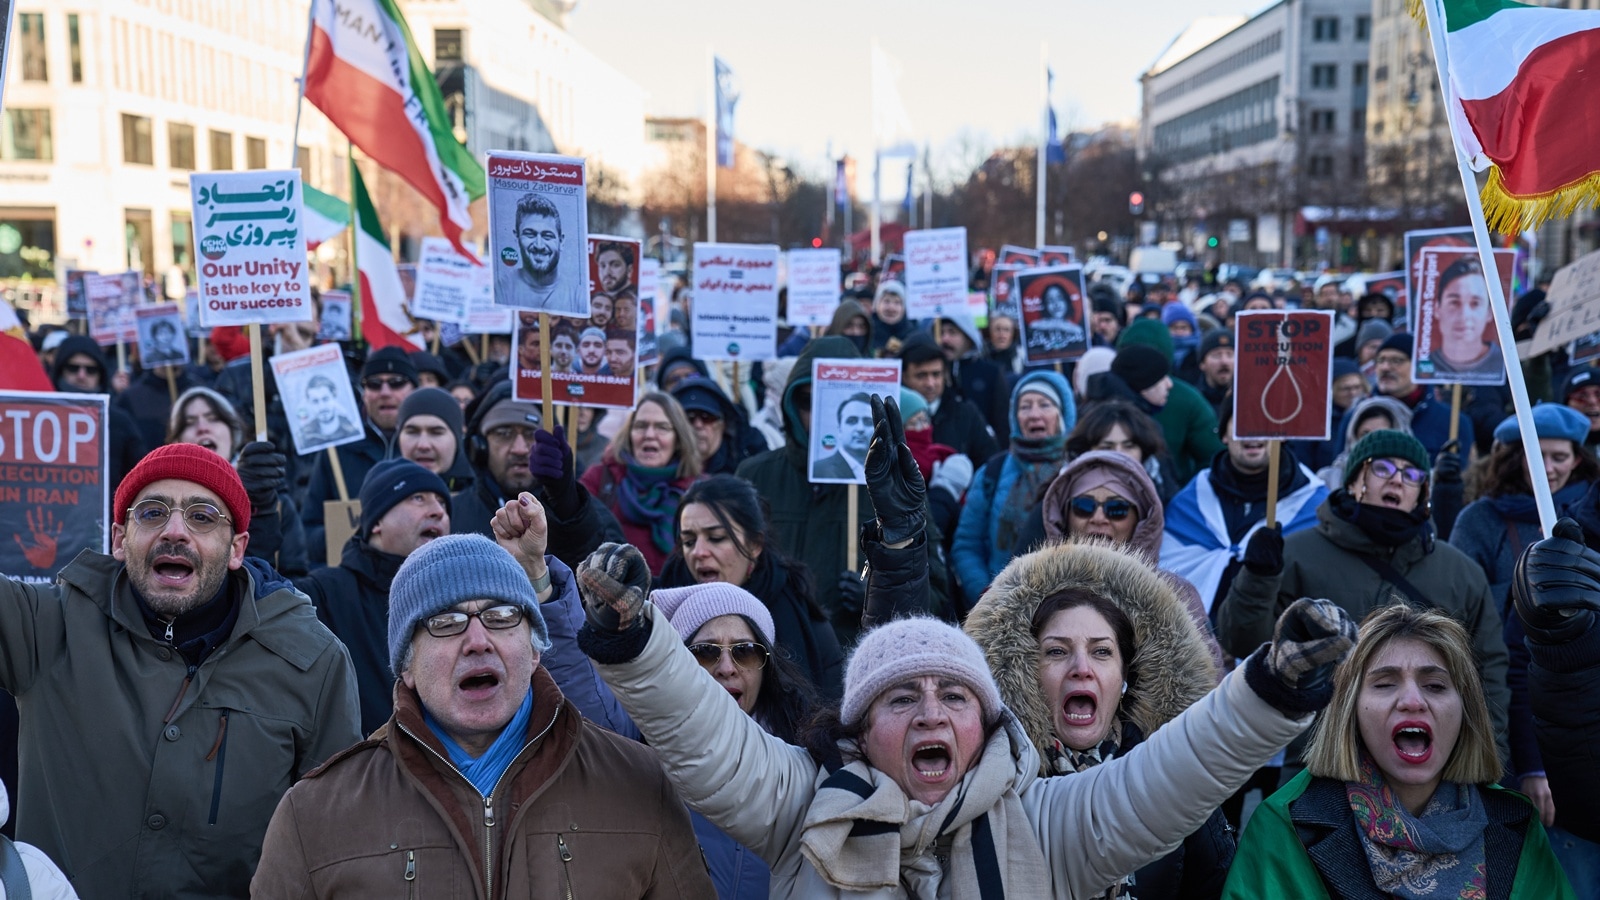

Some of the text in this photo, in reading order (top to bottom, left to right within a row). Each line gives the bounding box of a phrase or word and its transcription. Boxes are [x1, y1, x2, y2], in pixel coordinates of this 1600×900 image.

[533, 165, 578, 180] مسعود
[197, 180, 294, 205] اتحاد
[494, 179, 578, 195] Masoud ZatParvar
[205, 205, 296, 228] رمز
[202, 239, 225, 247] ECHO
[226, 223, 298, 250] پیروزی
[206, 245, 227, 253] IRAN
[202, 257, 302, 280] Our Unity
[205, 280, 301, 297] is the key to
[209, 298, 302, 311] Our success
[1247, 319, 1321, 338] STOP
[1548, 306, 1600, 341] HEL
[1244, 342, 1323, 352] EXECUTION
[1255, 356, 1308, 366] IN IRAN
[550, 371, 596, 384] XECUTIONS
[0, 466, 99, 486] XECUTION
[27, 487, 79, 505] IRAN
